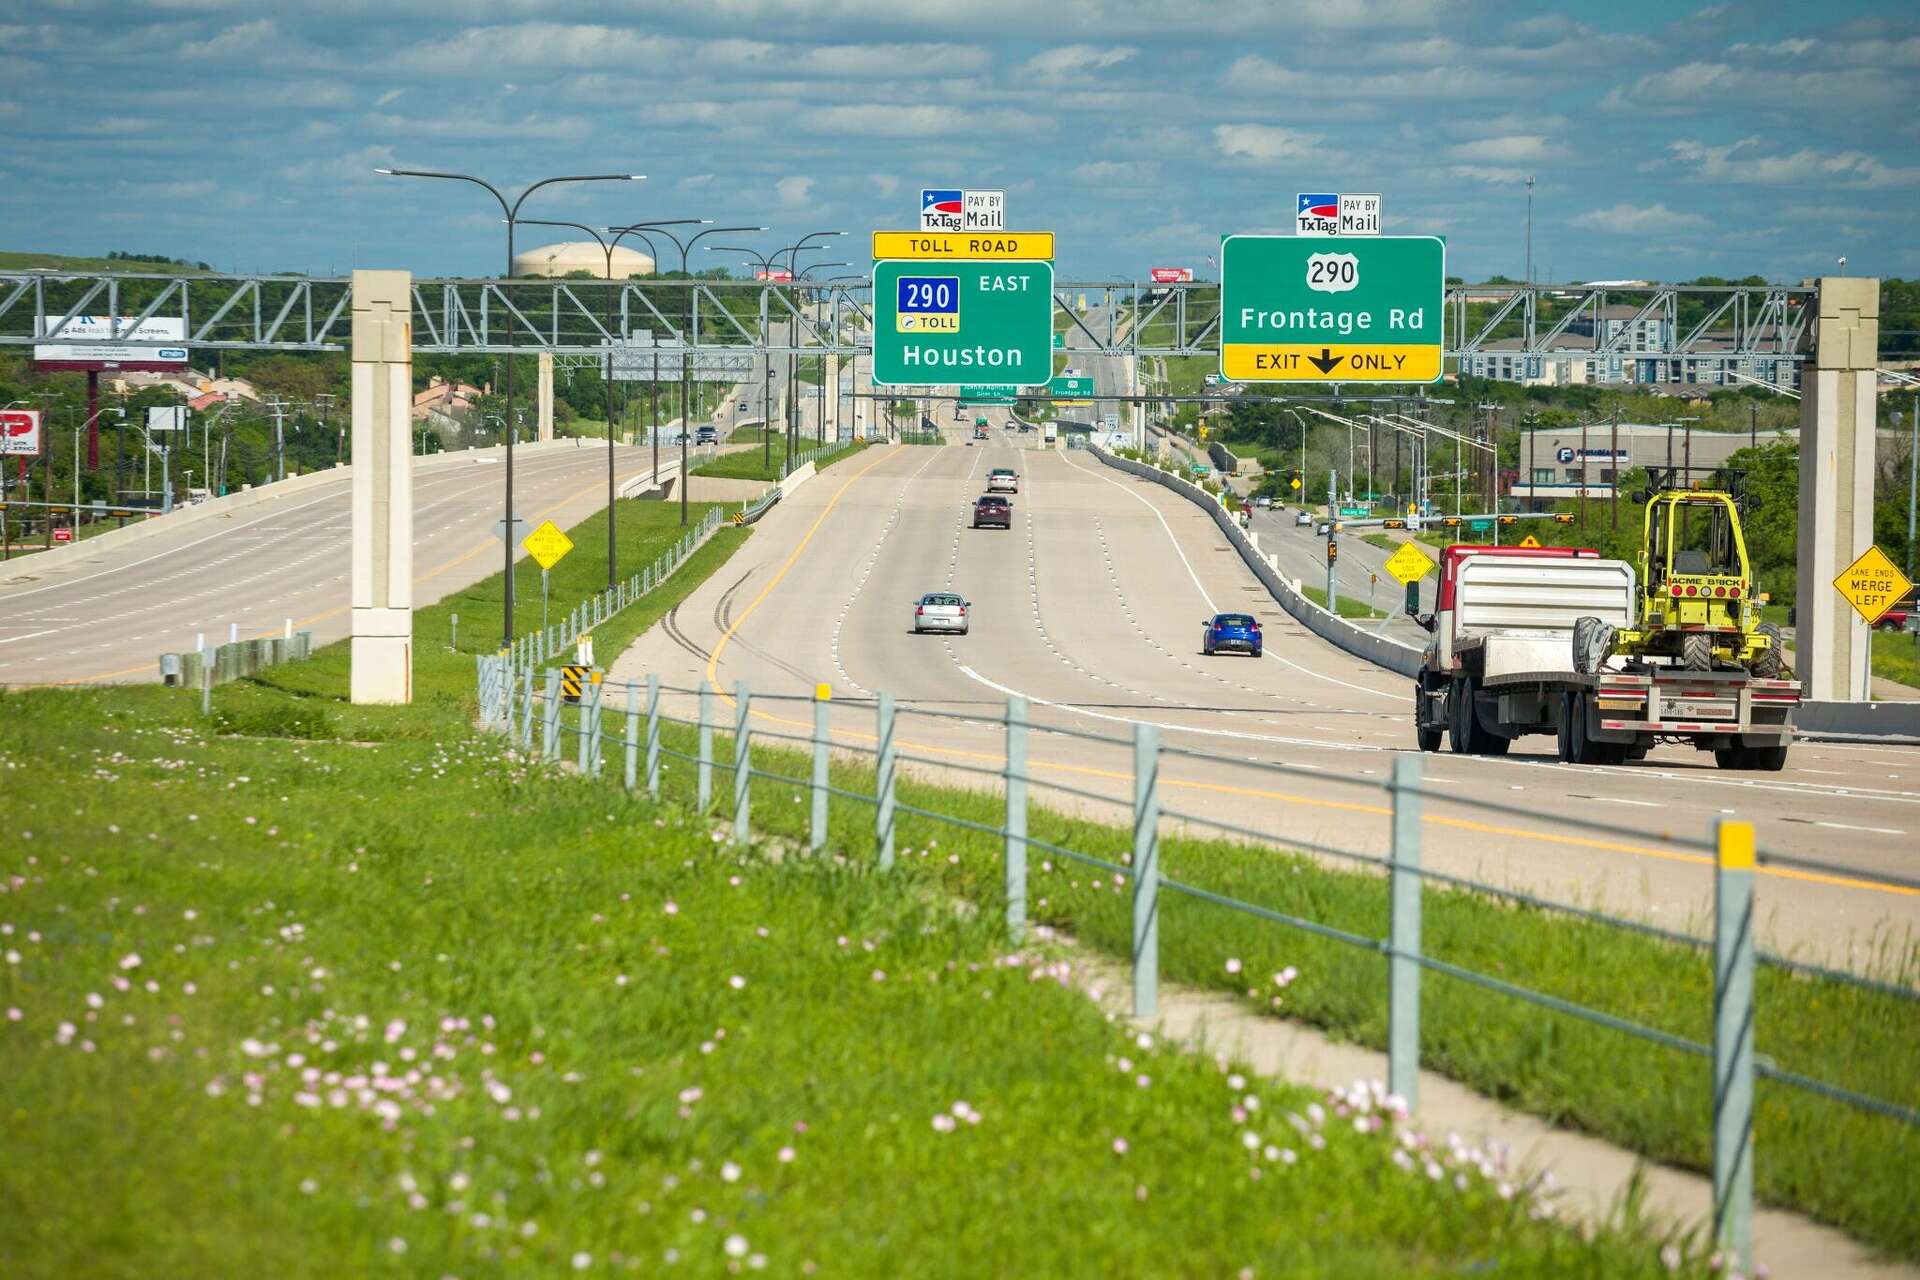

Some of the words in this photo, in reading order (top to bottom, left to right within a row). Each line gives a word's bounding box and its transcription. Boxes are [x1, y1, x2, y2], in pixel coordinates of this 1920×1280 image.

[968, 196, 985, 207] PAY
[989, 196, 1001, 207] BY
[1343, 200, 1361, 211] PAY
[1365, 200, 1377, 211] BY
[923, 213, 961, 232] TxTag
[966, 212, 1002, 227] Mail
[1298, 217, 1338, 235] TxTag
[1342, 215, 1378, 231] Mail
[909, 239, 953, 252] TOLL
[969, 239, 1018, 253] ROAD
[1311, 260, 1355, 284] 290
[979, 275, 1031, 292] EAST
[906, 283, 950, 309] 290
[920, 317, 956, 328] TOLL
[1240, 307, 1373, 335] Frontage
[1389, 307, 1423, 329] Rd
[903, 345, 1023, 367] Houston
[1256, 354, 1300, 370] EXIT
[1351, 354, 1407, 370] ONLY
[1851, 568, 1870, 577] LANE
[1874, 568, 1894, 578] ENDS
[1671, 577, 1703, 585] ACME
[1706, 578, 1741, 586] BRICK
[1851, 580, 1893, 592] MERGE
[1856, 594, 1887, 606] LEFT
